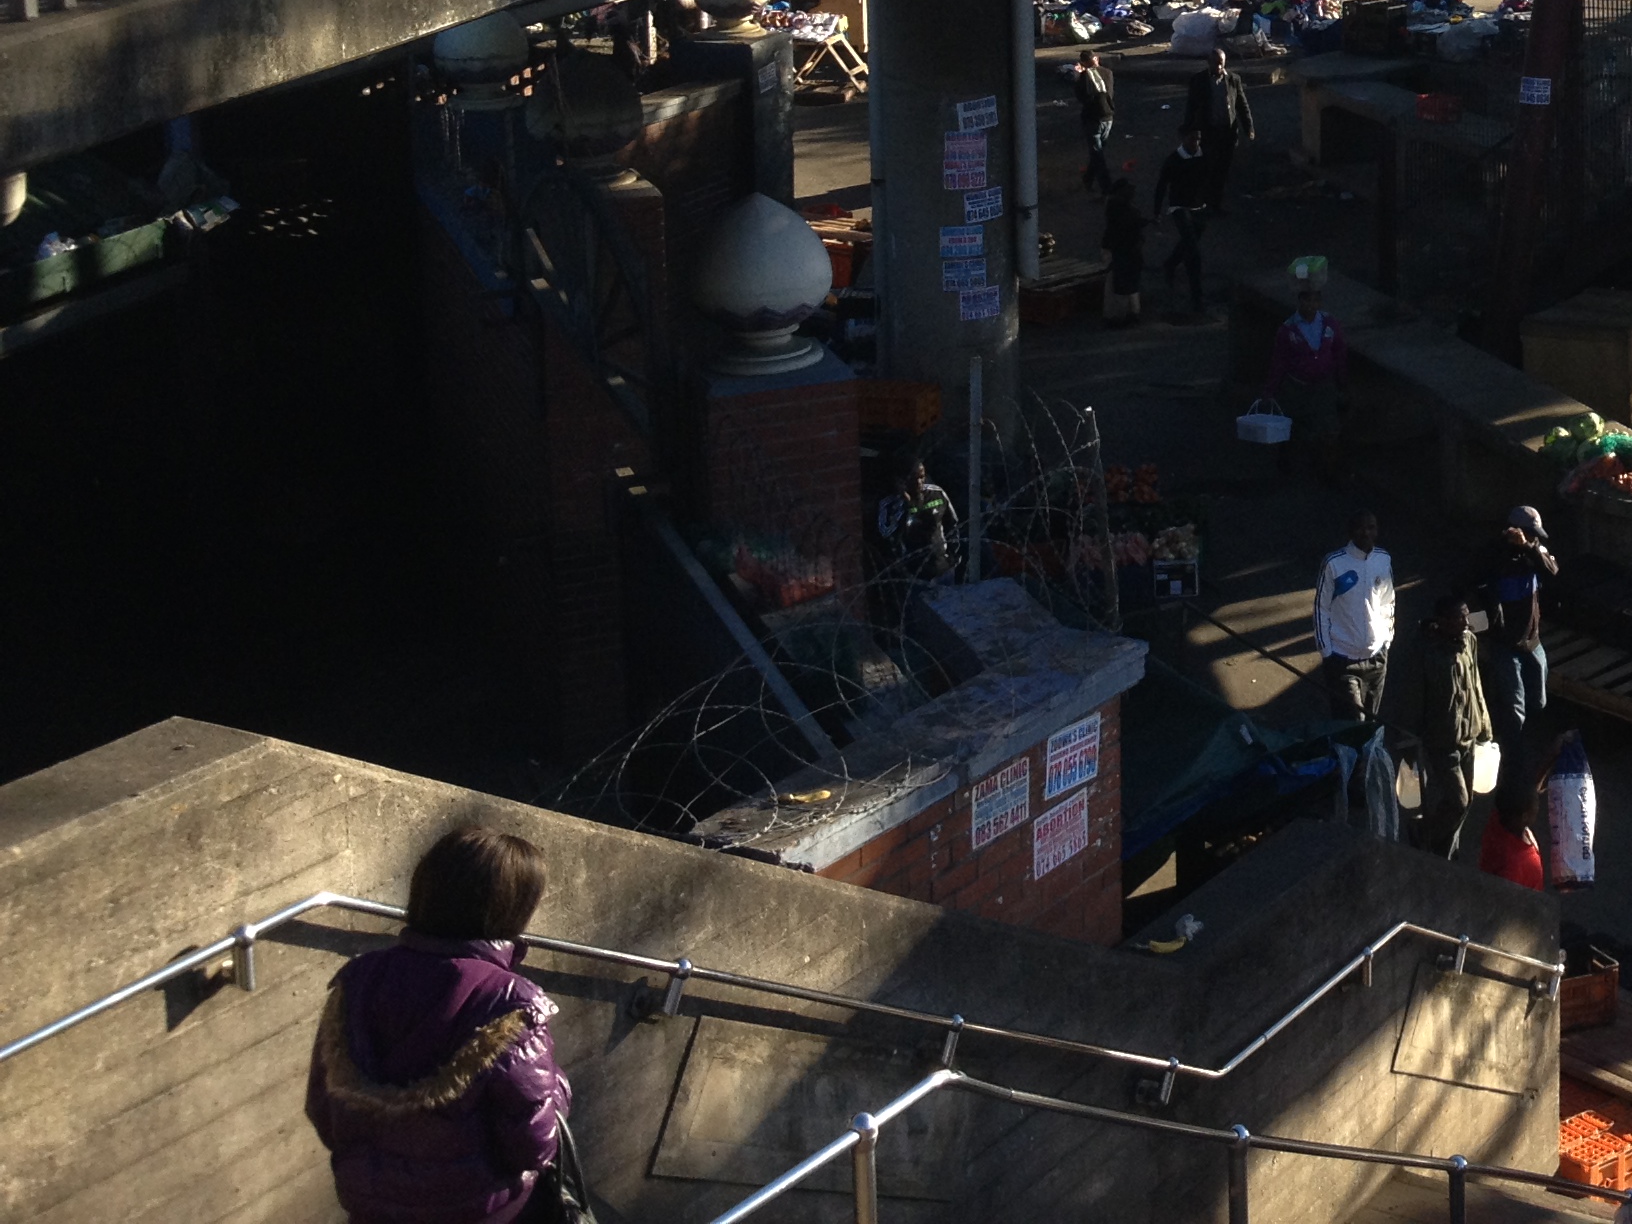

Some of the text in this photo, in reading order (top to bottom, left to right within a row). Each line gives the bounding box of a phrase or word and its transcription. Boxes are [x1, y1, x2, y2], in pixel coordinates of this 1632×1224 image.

[974, 775, 998, 802] ZAMA
[999, 759, 1029, 788] CLINIC
[1035, 798, 1085, 842] ABORTION
